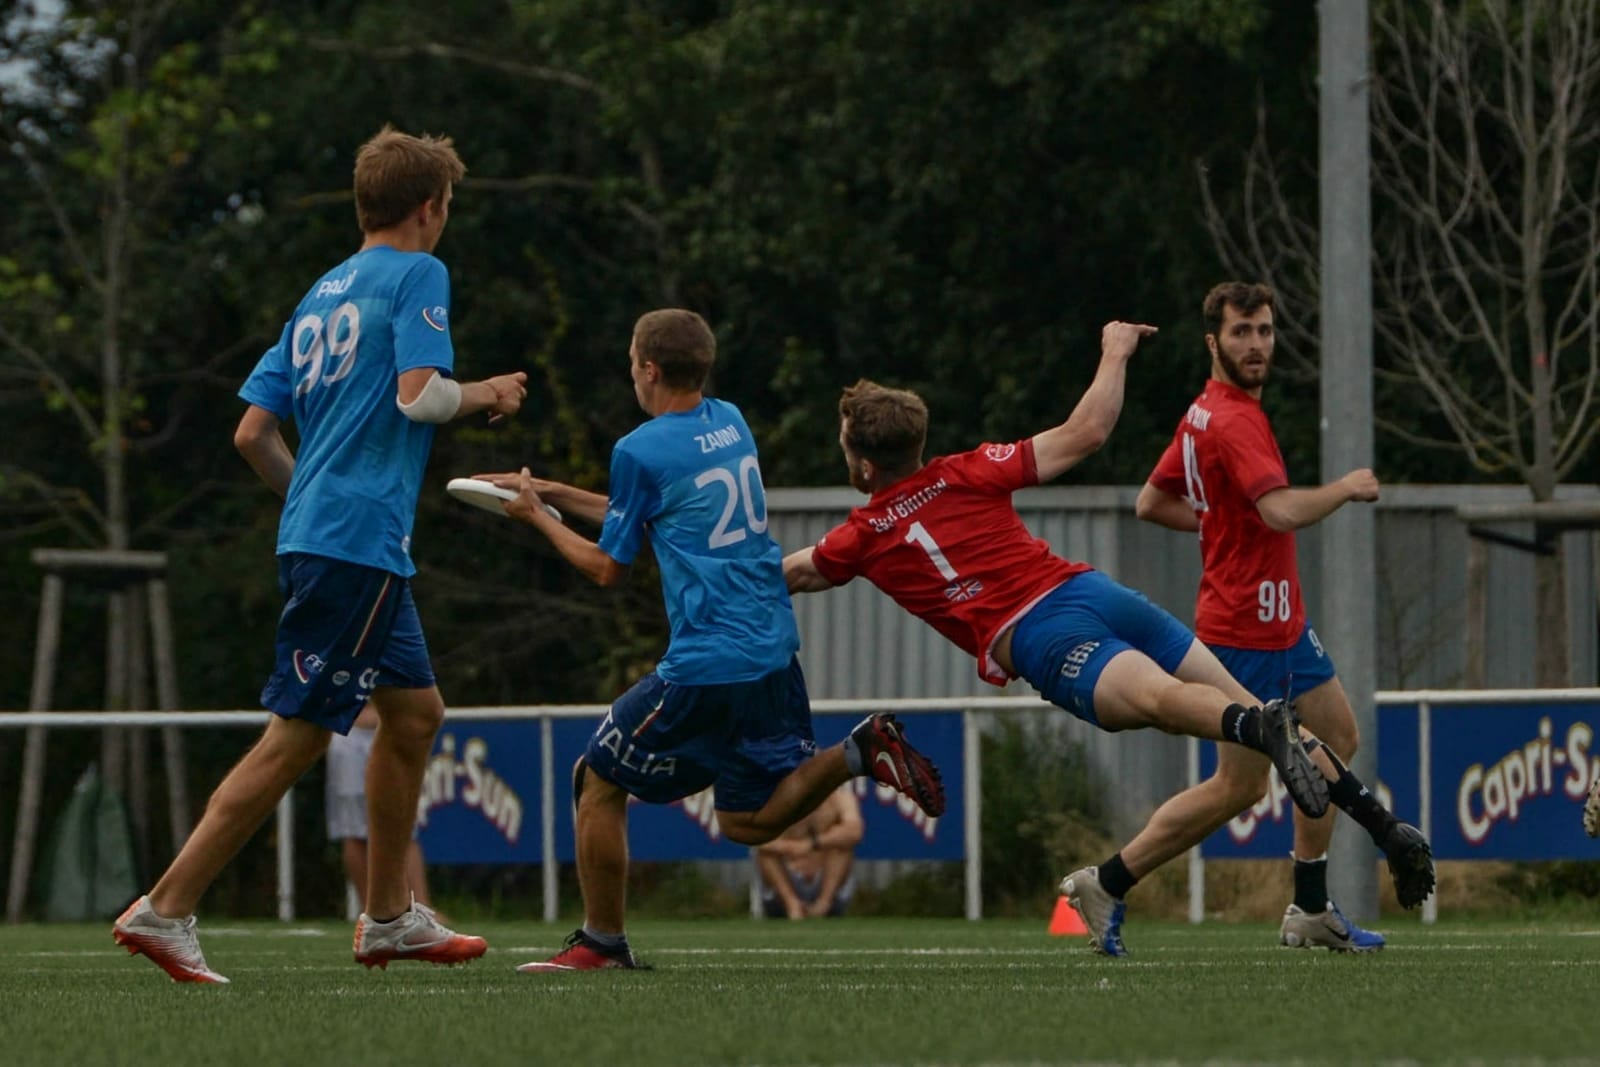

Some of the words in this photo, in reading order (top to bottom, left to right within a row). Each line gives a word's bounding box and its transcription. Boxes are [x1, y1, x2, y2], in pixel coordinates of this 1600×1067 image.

[292, 301, 361, 400] 99
[693, 424, 742, 454] ZANNI
[694, 455, 768, 550] 20
[904, 520, 958, 582] 1
[1257, 579, 1291, 623] 98
[596, 705, 677, 776] TALIA
[1457, 716, 1600, 847] Capri-S
